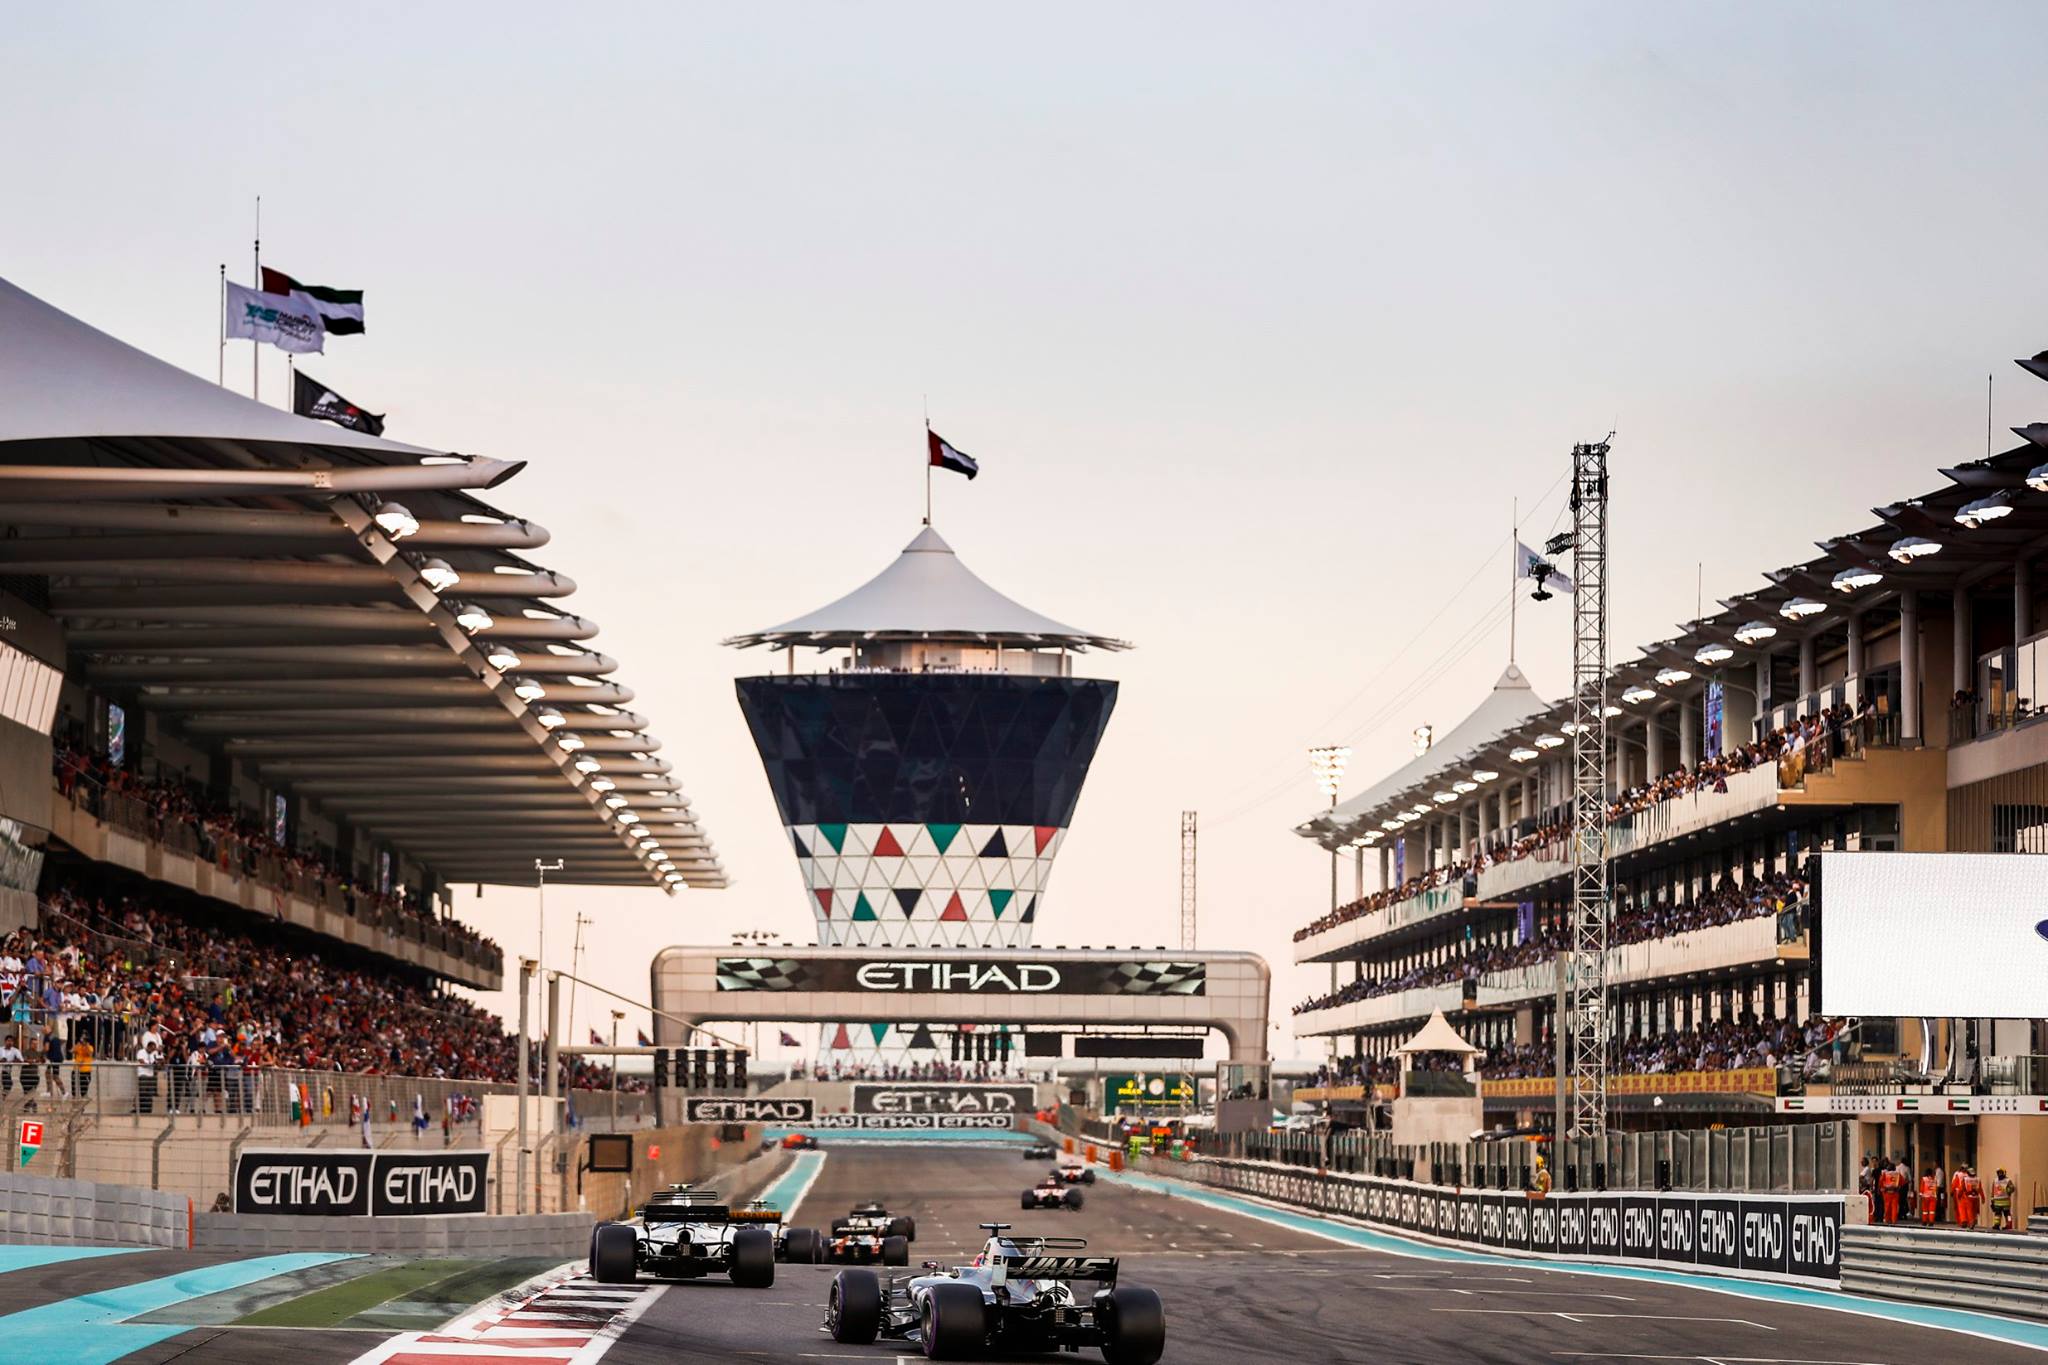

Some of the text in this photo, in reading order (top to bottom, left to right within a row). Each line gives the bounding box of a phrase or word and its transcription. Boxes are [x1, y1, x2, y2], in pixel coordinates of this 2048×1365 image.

[856, 963, 1060, 991] ETIHAD
[695, 1102, 805, 1119] ETIHAD
[865, 1116, 930, 1127] ETIHAD
[942, 1117, 1007, 1127] ETIHAD
[26, 1126, 39, 1142] F
[250, 1165, 358, 1204] ETIHAD
[385, 1165, 476, 1204] ETIHAD
[1459, 1202, 1479, 1234] ETIHAD
[1482, 1204, 1502, 1238] ETIHAD
[1506, 1206, 1528, 1241] ETIHAD
[1532, 1208, 1555, 1243] ETIHAD
[1560, 1207, 1586, 1244] ETIHAD
[1591, 1207, 1618, 1246] ETIHAD
[1624, 1208, 1654, 1248] ETIHAD
[1660, 1208, 1693, 1251] ETIHAD
[1700, 1209, 1736, 1256] ETIHAD
[1744, 1212, 1783, 1259] ETIHAD
[1793, 1214, 1836, 1265] ETIHAD
[1011, 1257, 1111, 1277] HAAS
